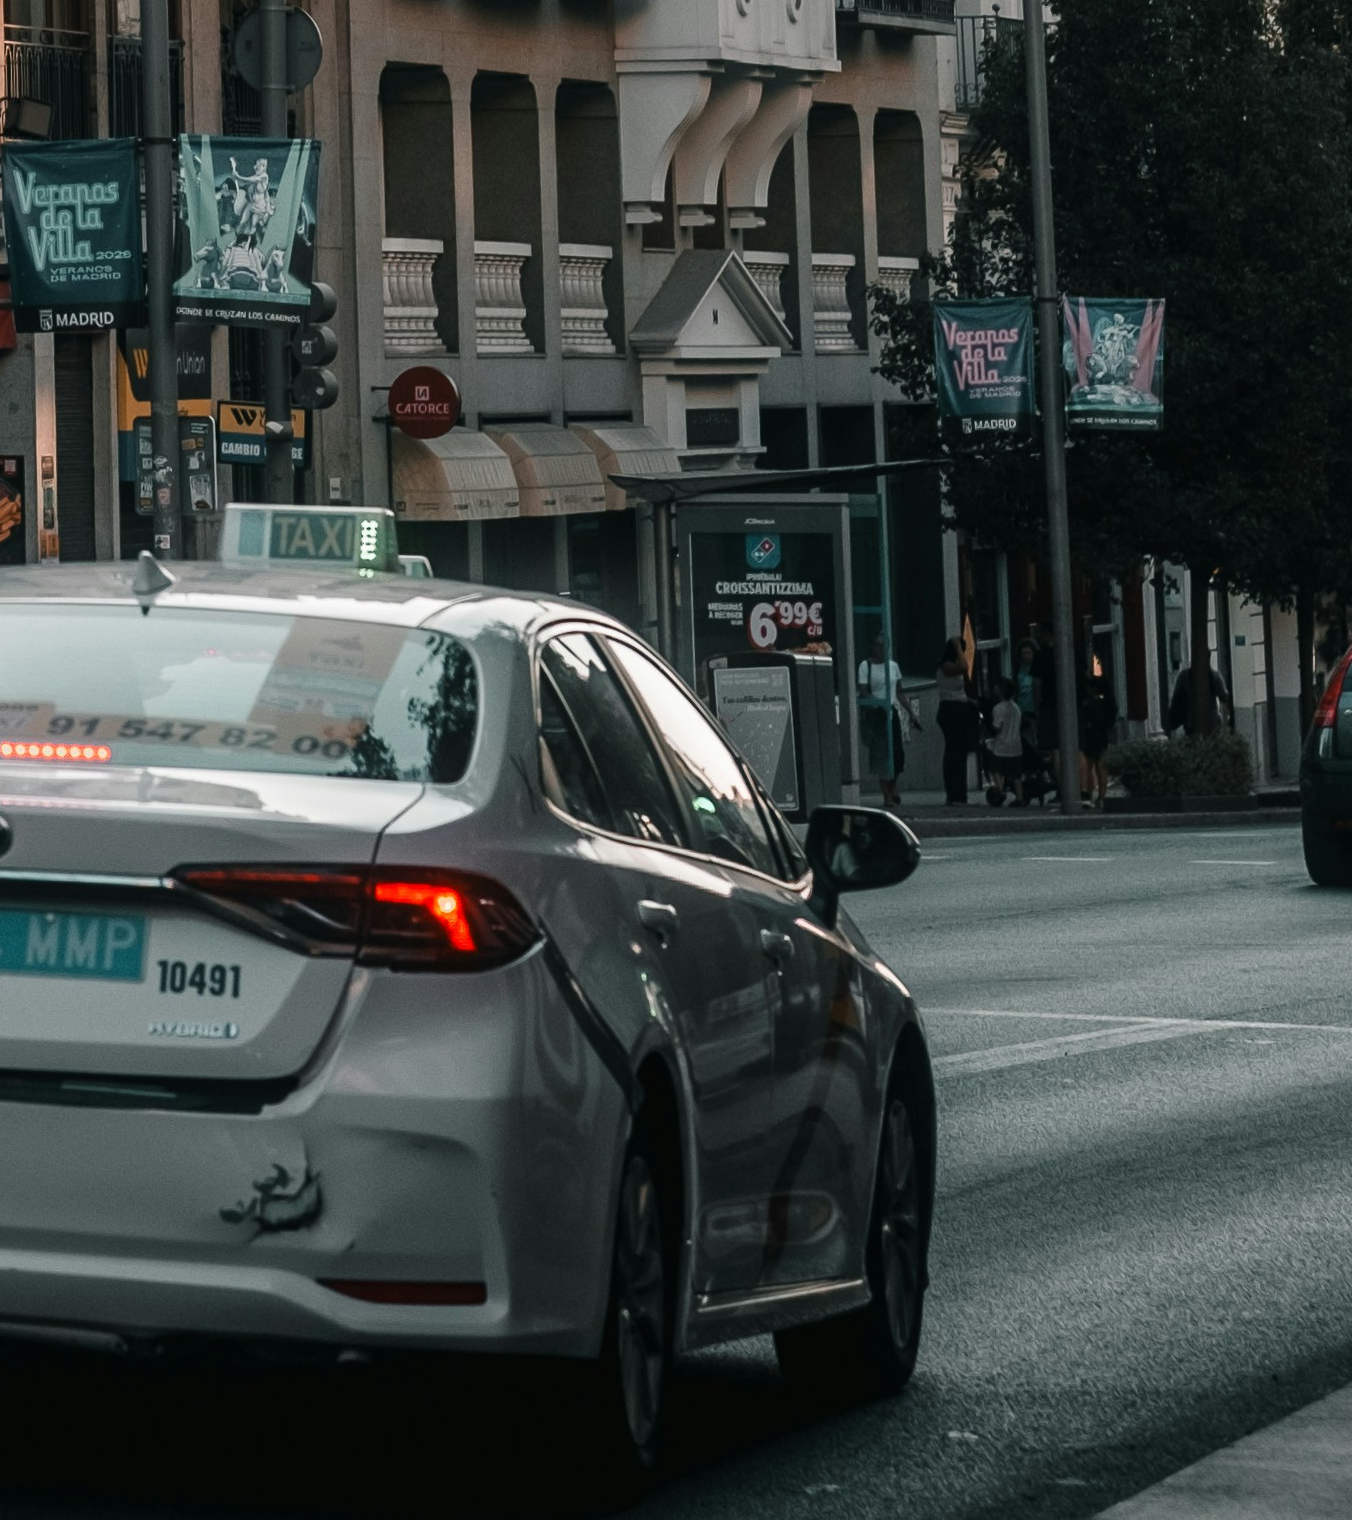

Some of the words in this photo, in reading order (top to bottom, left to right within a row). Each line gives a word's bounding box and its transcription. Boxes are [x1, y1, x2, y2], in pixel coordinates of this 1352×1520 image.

[13, 169, 119, 215] Veranos
[27, 225, 95, 272] Villa
[50, 265, 113, 274] VERANOS
[50, 275, 67, 283] DE
[71, 272, 121, 281] MADRID
[56, 312, 114, 327] MADRID
[215, 309, 247, 320] CRUZAN
[248, 311, 263, 320] LOS
[941, 317, 1019, 350] Veranos
[953, 359, 1001, 391] Villa
[396, 402, 450, 414] CATORCE
[974, 418, 1017, 431] MADRID
[221, 441, 261, 457] CAMBIO
[273, 516, 354, 557] TAXI
[715, 581, 814, 596] CROISSANTIZZIMA
[47, 716, 100, 736] 91
[118, 719, 204, 742] 547
[219, 727, 277, 751] 82
[292, 735, 349, 760] 00
[25, 914, 137, 971] MMP
[157, 960, 241, 999] 10491
